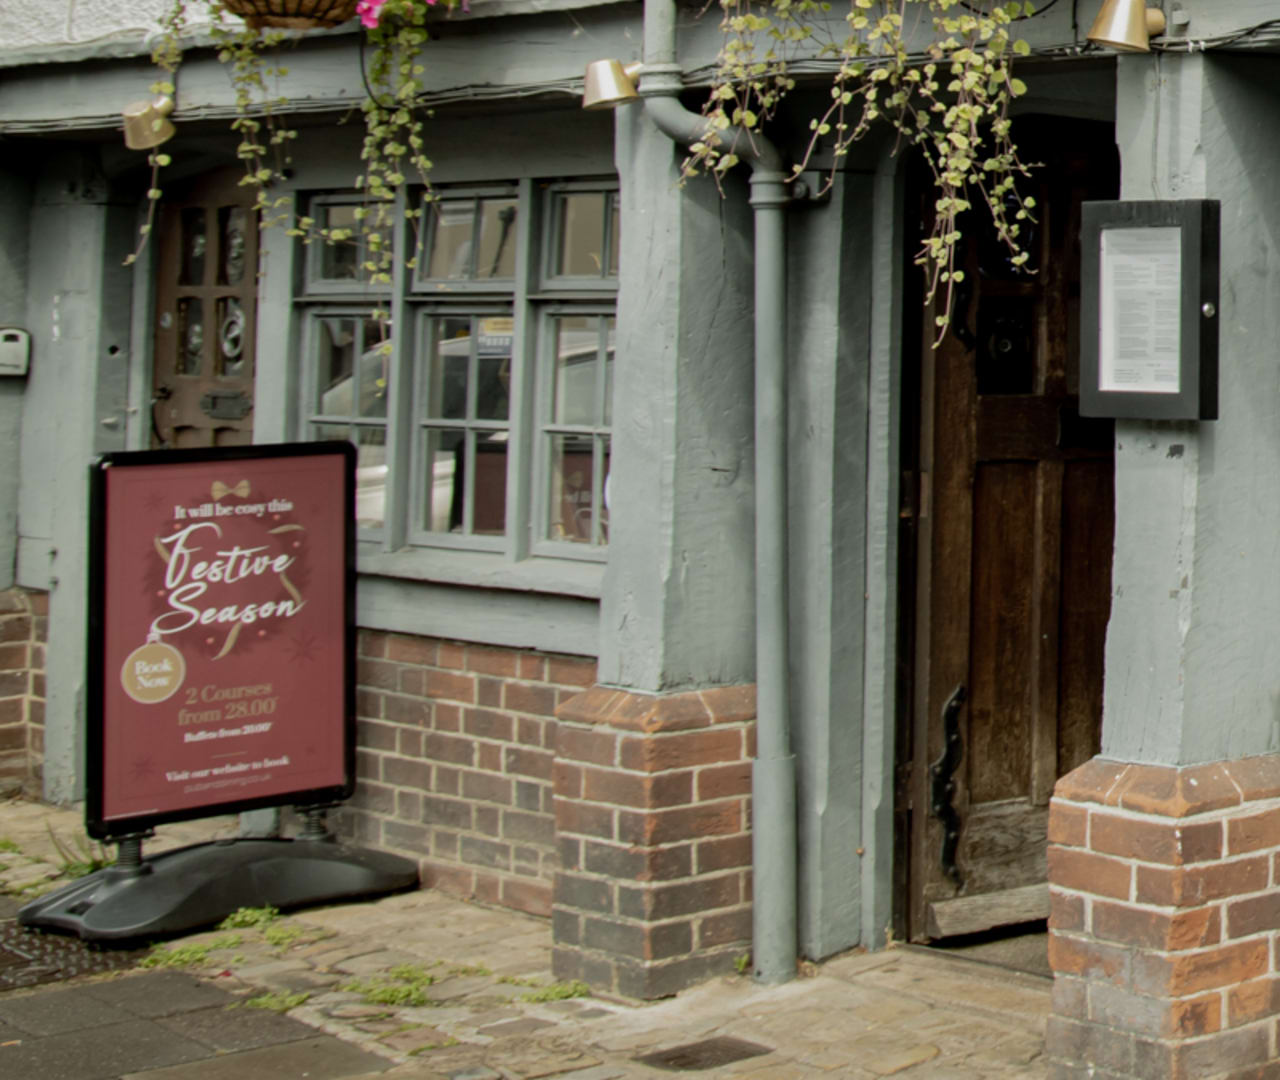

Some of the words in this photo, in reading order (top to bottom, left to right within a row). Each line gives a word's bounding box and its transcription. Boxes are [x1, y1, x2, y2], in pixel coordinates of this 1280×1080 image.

[188, 503, 214, 518] will
[214, 502, 234, 516] be
[159, 521, 297, 589] Festive
[151, 580, 308, 635] Season
[135, 658, 173, 676] Book
[136, 674, 170, 690] Now
[185, 687, 198, 705] 2
[201, 683, 273, 703] Courses
[178, 709, 222, 726] from
